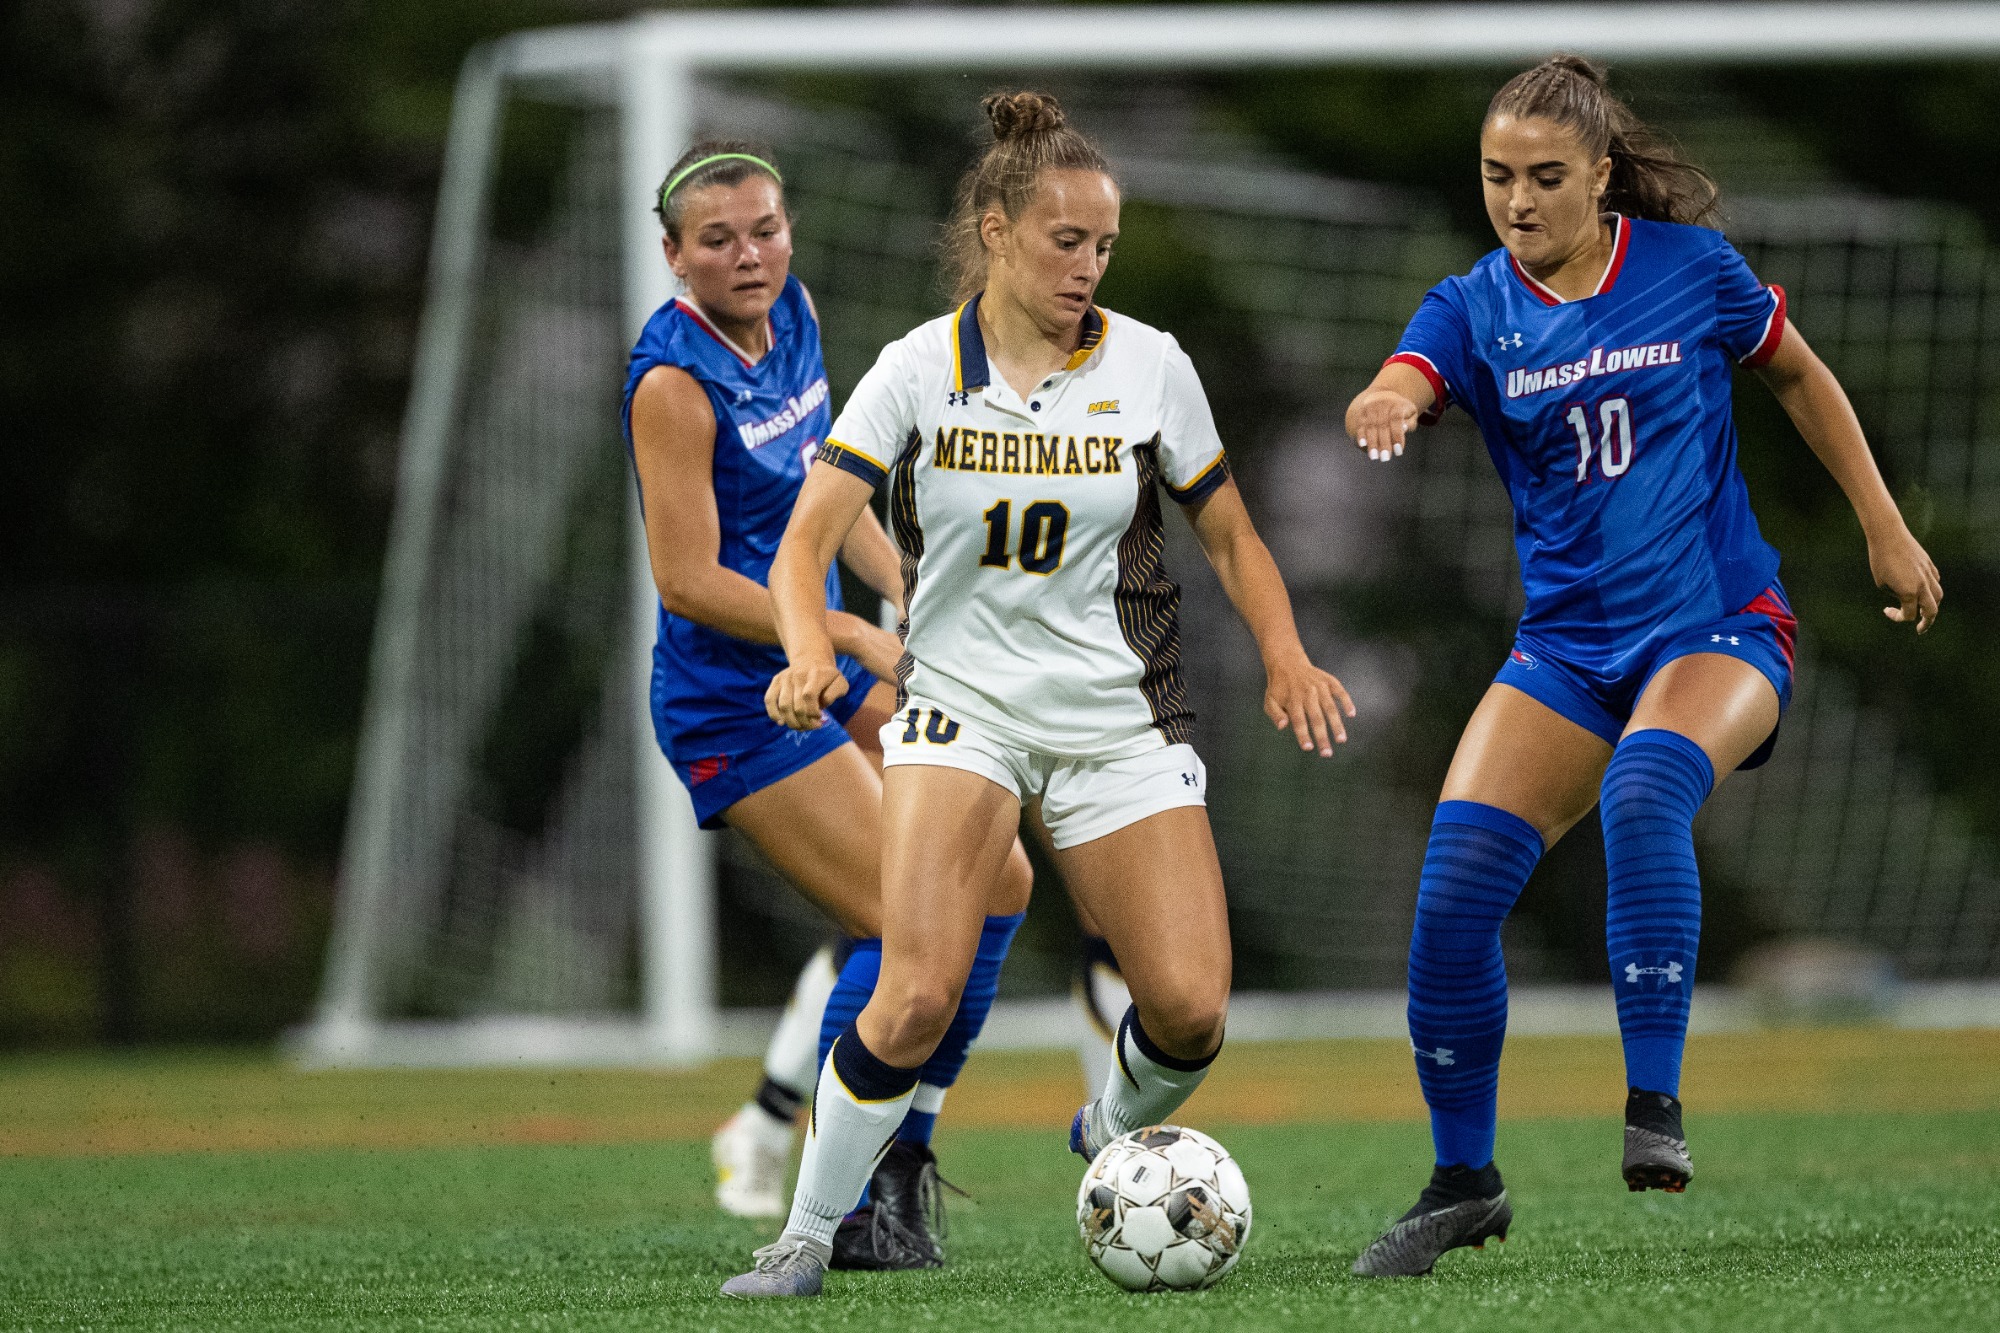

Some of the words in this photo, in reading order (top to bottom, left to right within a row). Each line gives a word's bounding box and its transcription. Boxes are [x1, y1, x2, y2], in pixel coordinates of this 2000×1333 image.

[1087, 400, 1119, 414] NEC
[934, 426, 1123, 476] MERRIMACK
[1564, 396, 1635, 485] 10
[979, 498, 1070, 576] 10
[901, 707, 960, 746] 10
